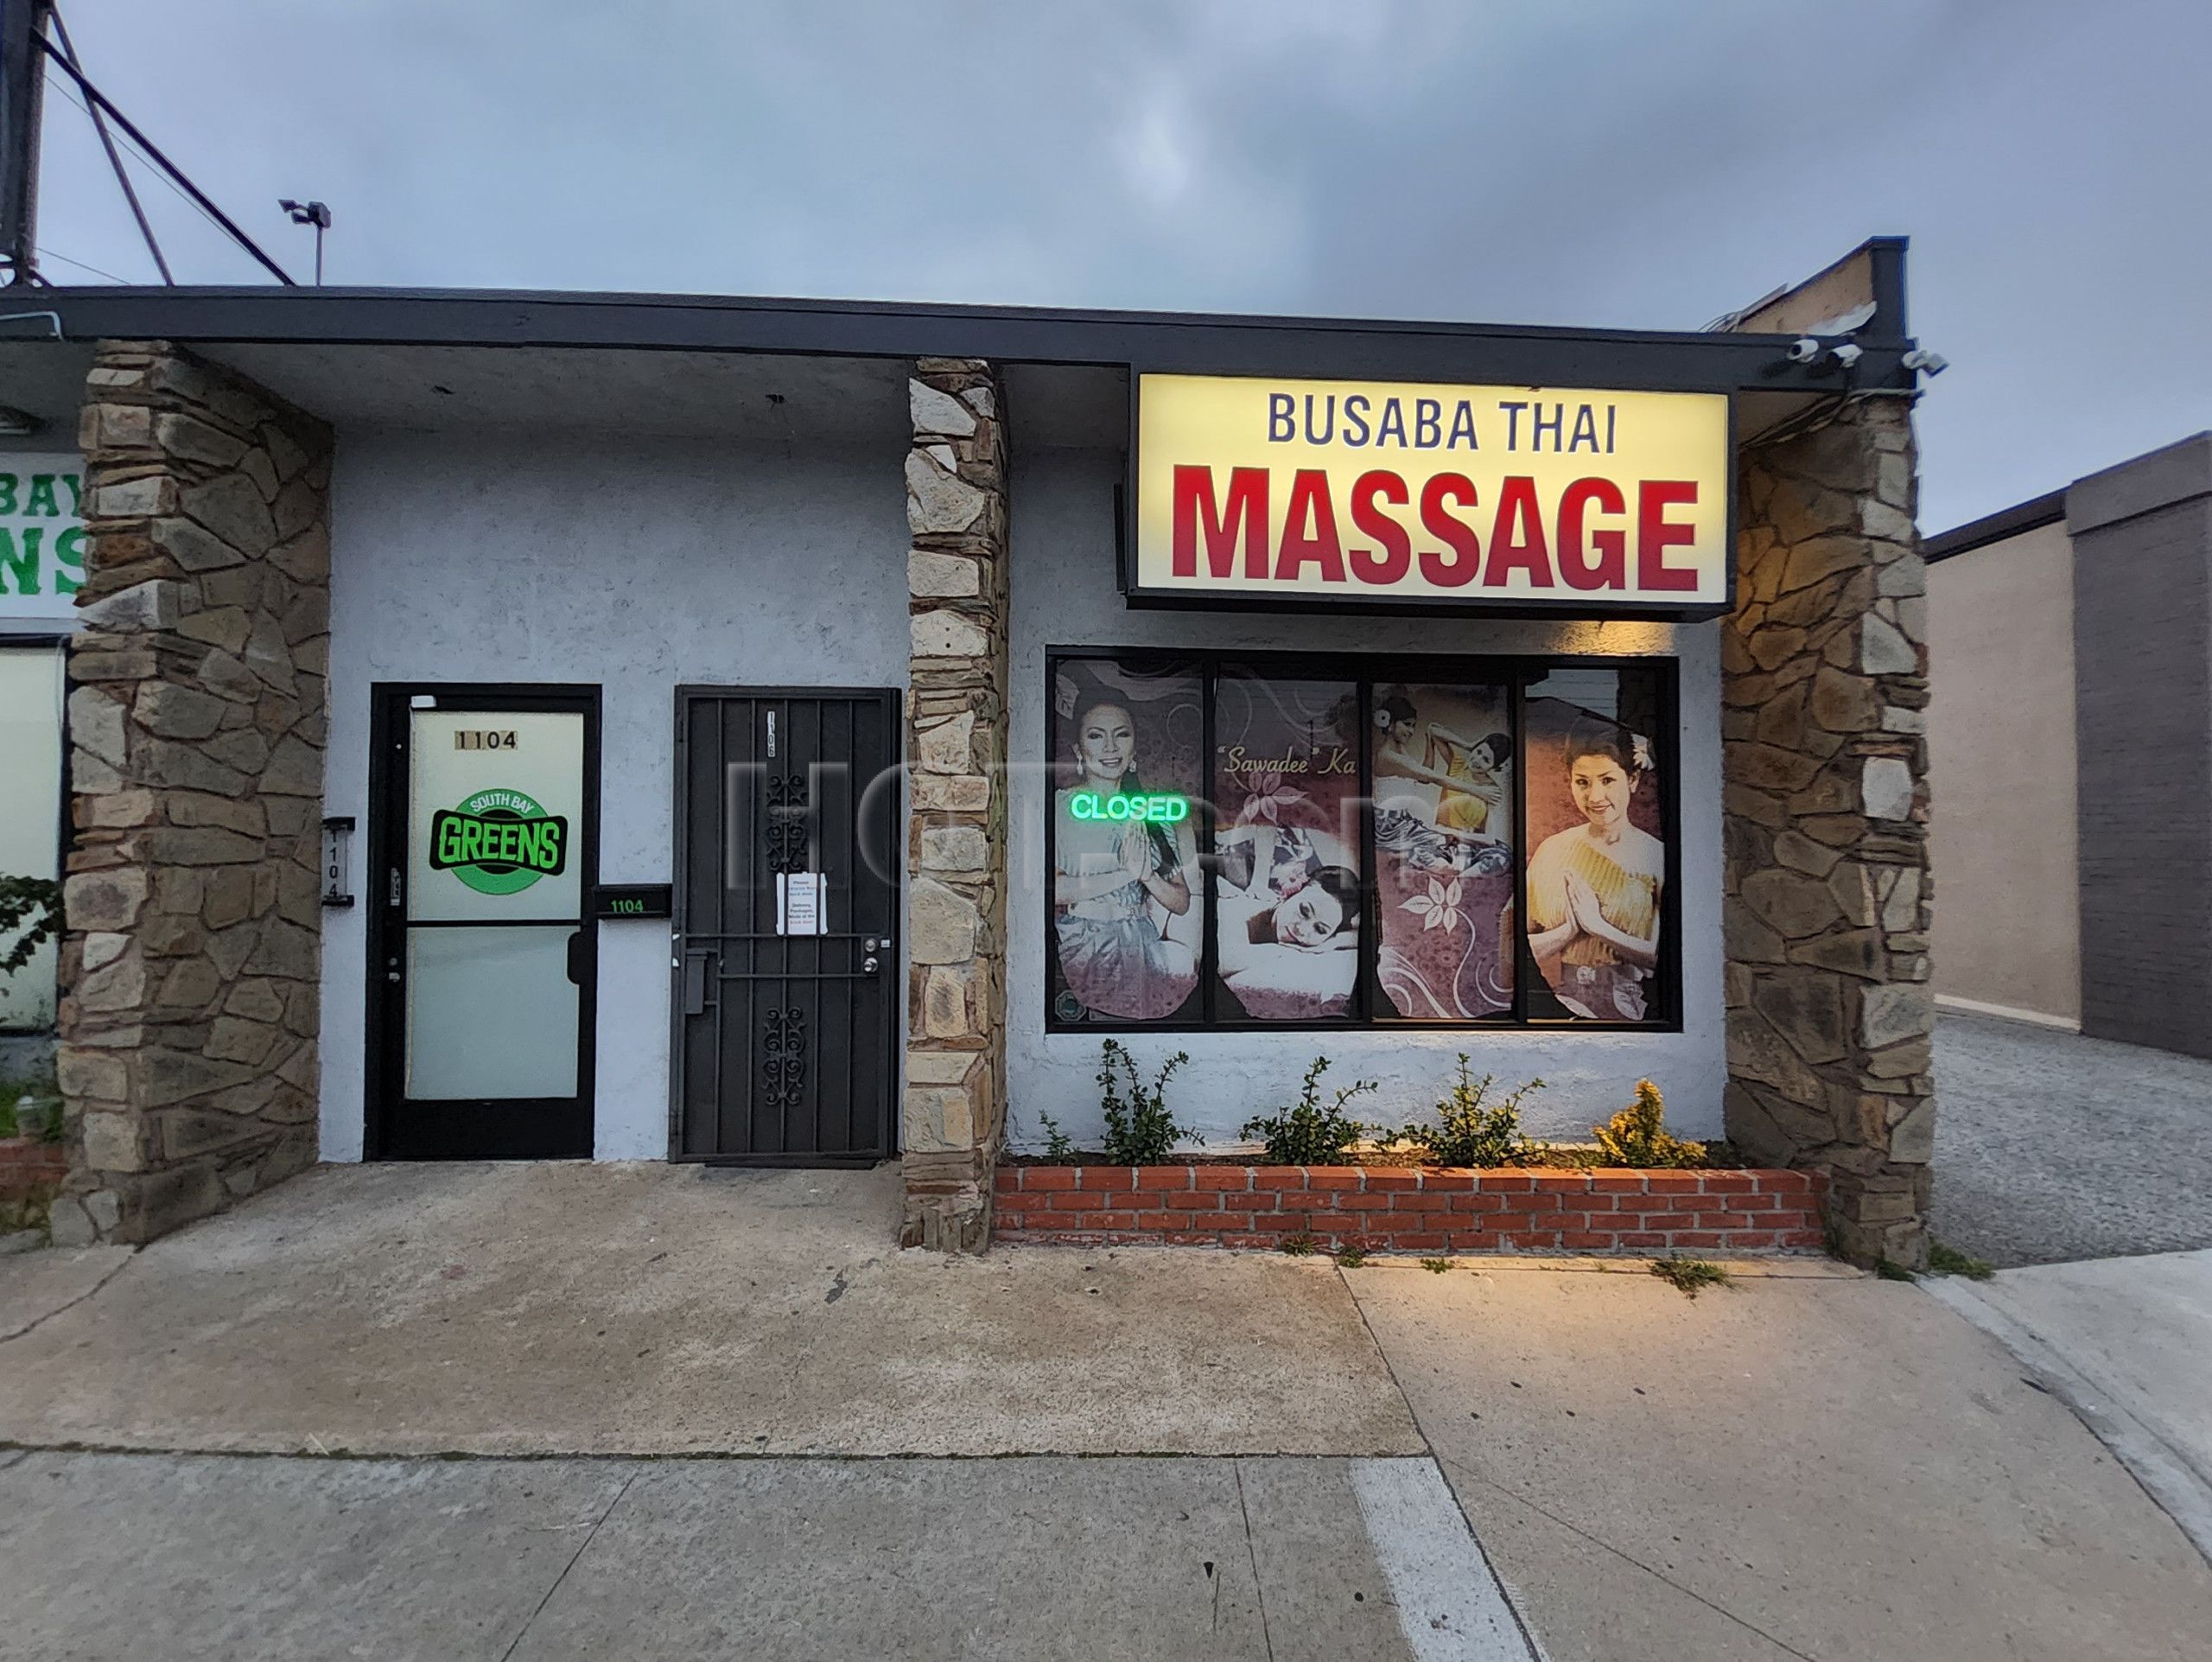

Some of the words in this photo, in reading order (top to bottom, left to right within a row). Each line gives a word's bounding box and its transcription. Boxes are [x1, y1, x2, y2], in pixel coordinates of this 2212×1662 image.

[1268, 392, 1479, 451] BUSABA
[1499, 401, 1617, 455] THAI
[1172, 463, 1700, 592] MASSAGE
[460, 730, 517, 749] 1104
[1317, 748, 1357, 774] Ka
[469, 793, 511, 812] SOUTH
[511, 795, 535, 814] BAY
[1071, 793, 1187, 822] CLOSED
[438, 816, 560, 869] GREENS
[611, 899, 644, 914] 1104
